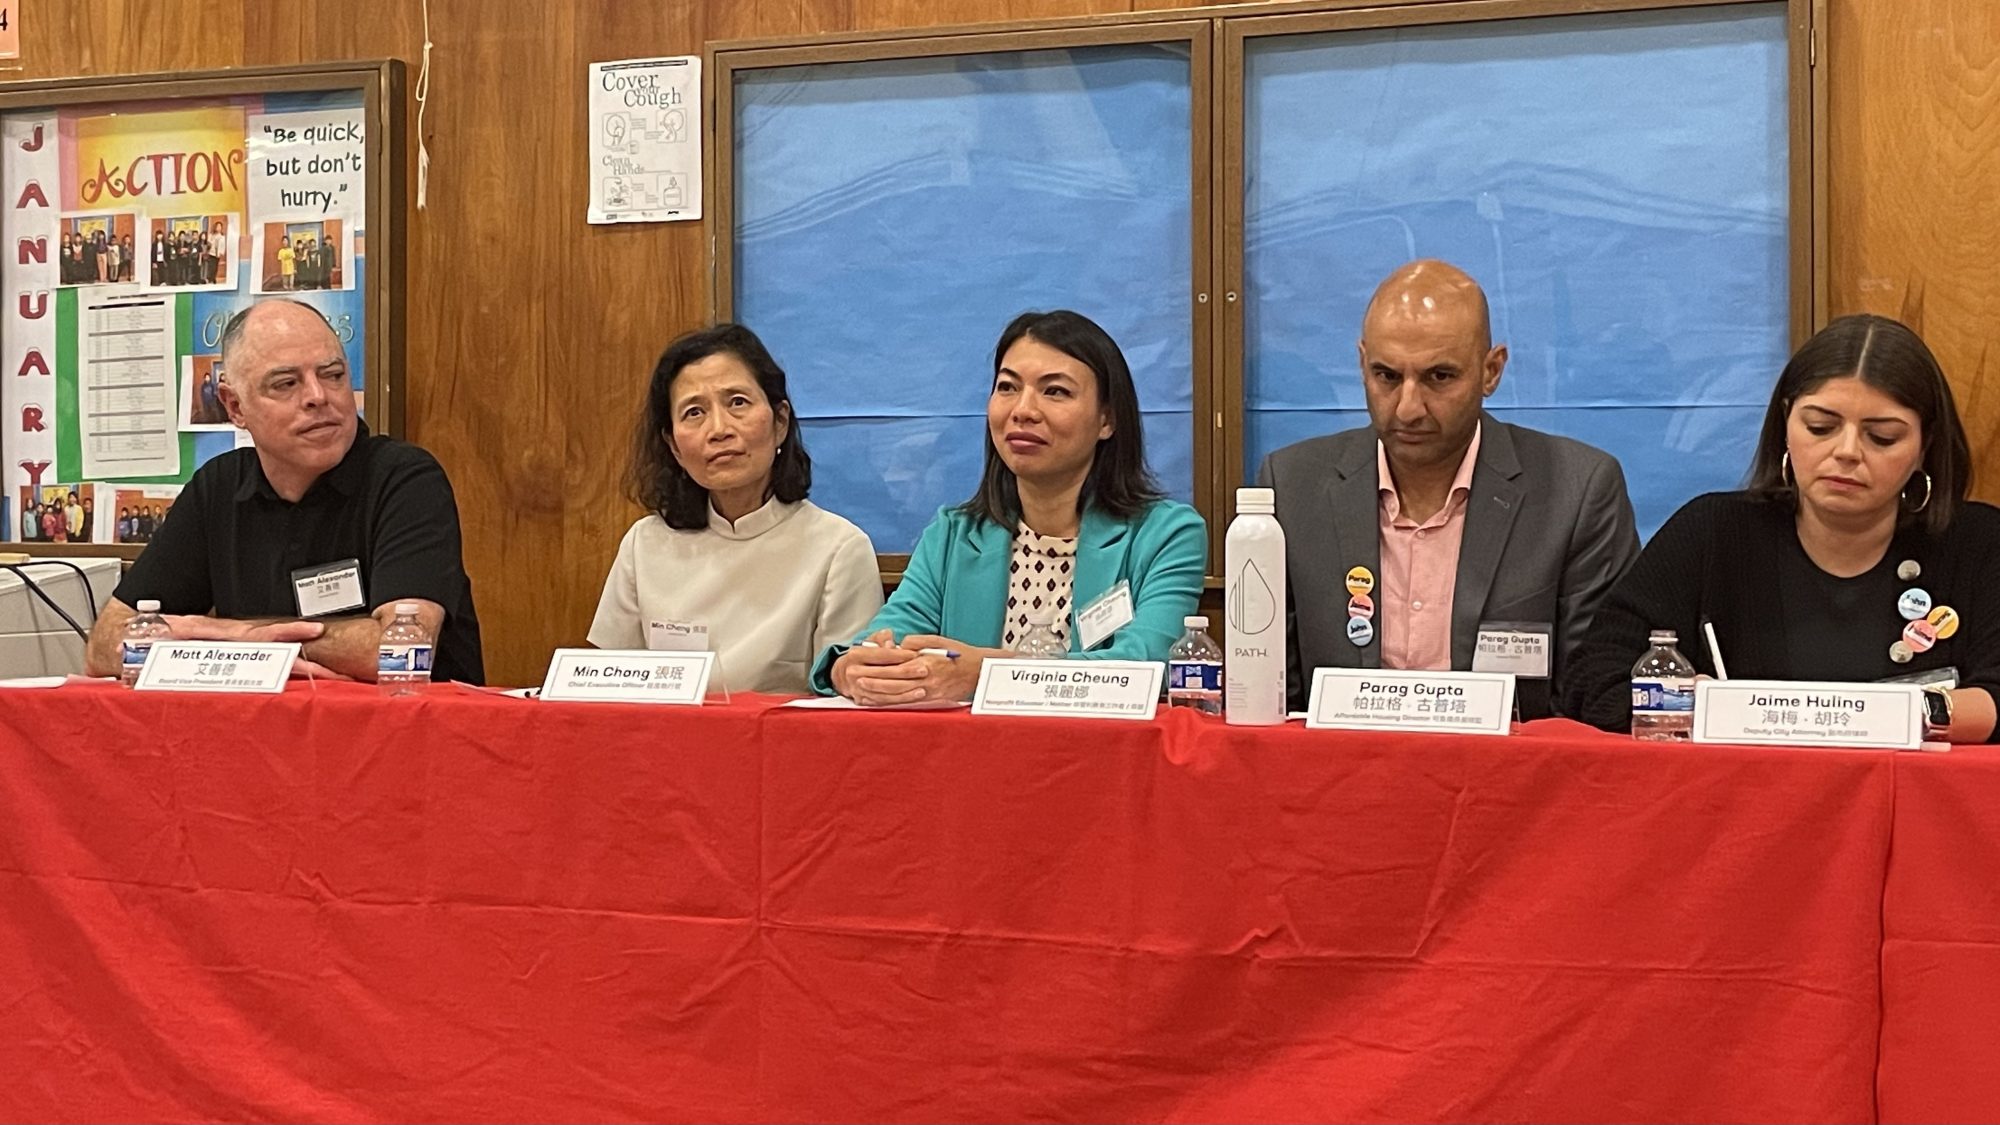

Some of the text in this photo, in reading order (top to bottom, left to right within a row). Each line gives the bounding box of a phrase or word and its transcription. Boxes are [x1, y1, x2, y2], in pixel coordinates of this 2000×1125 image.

[602, 71, 659, 92] Cover
[624, 86, 682, 110] Cough
[304, 121, 364, 145] quick,
[266, 152, 361, 176] but don't
[81, 149, 244, 204] ACTION
[651, 622, 665, 630] Min
[1480, 634, 1540, 645] Parag Gupta
[170, 649, 273, 662] Matt Alexander
[573, 666, 599, 678] Min
[1011, 670, 1130, 687] Virginia Cheung
[1359, 681, 1464, 698] Parag Gupta
[1748, 694, 1865, 713] Jaime Huling
